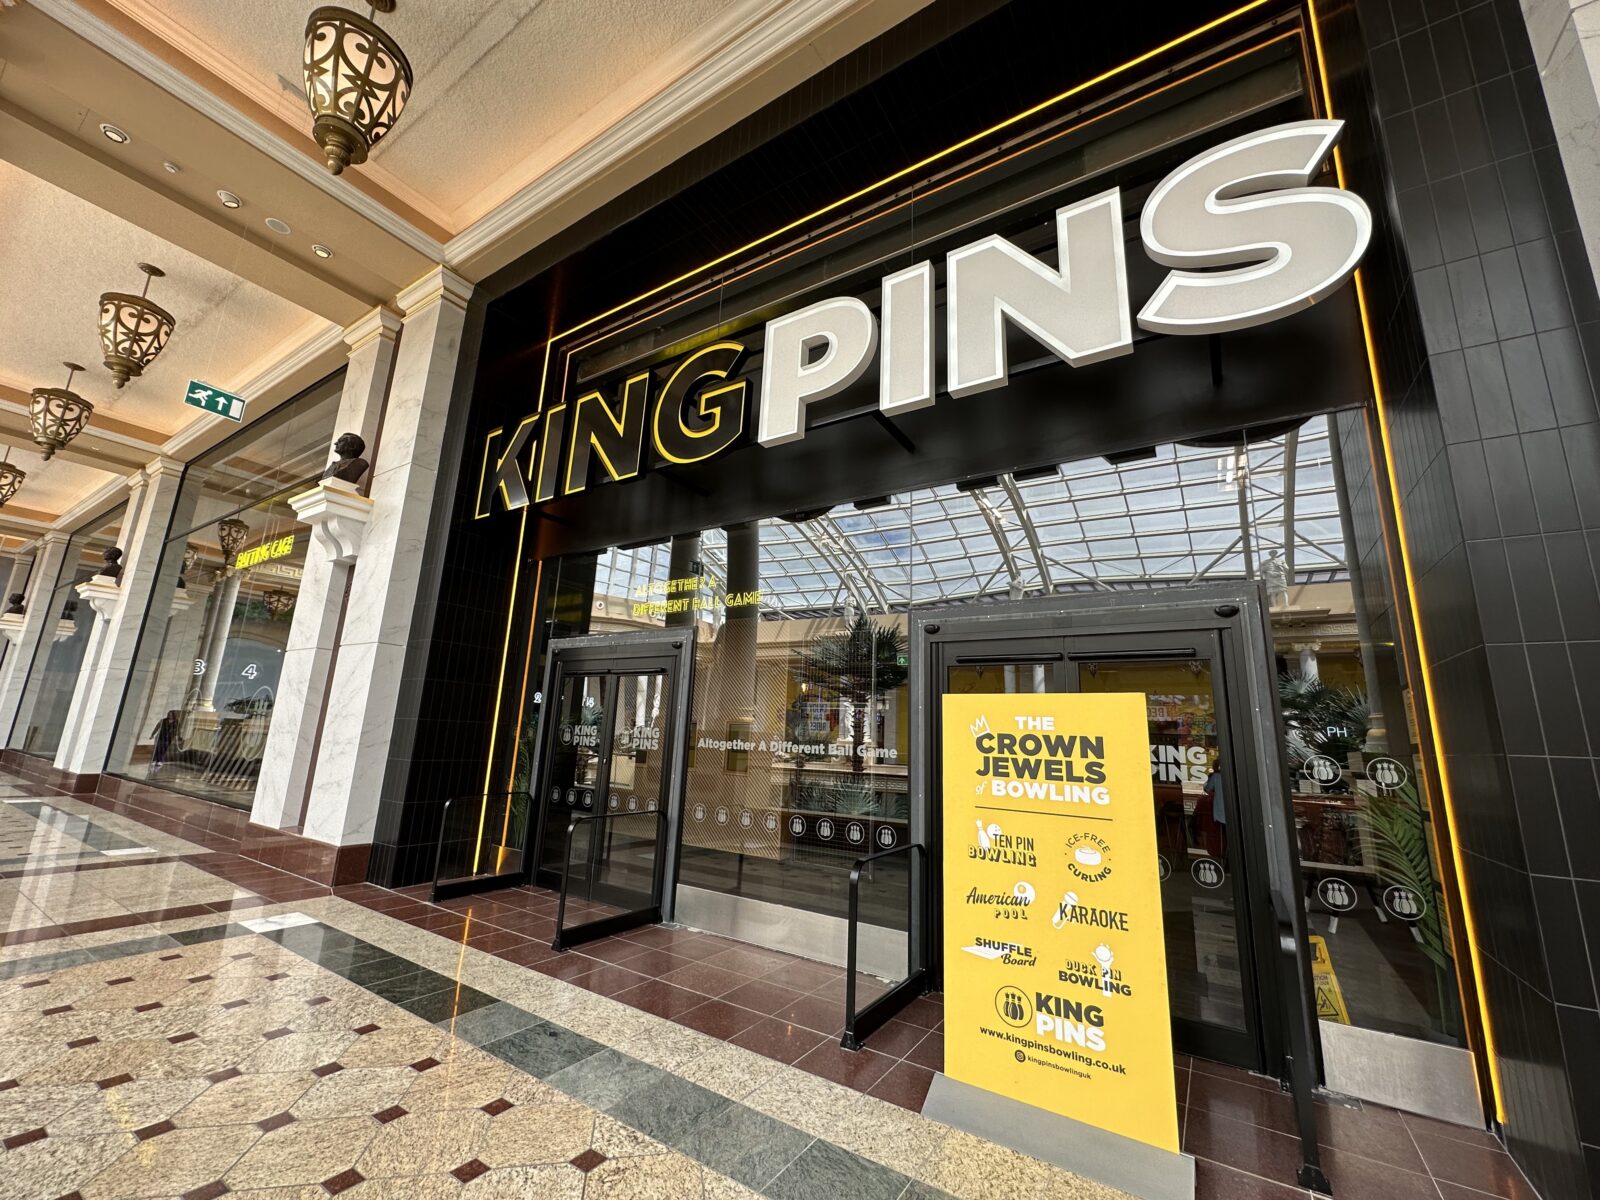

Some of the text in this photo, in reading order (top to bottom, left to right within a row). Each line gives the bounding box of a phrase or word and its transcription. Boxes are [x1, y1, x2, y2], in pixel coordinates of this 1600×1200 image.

[235, 534, 295, 569] BATTING CAGE
[634, 575, 718, 597] ALTOGETHER A
[633, 599, 690, 616] DIFFERENT
[724, 590, 763, 607] GAME
[193, 658, 206, 675] 3
[241, 664, 258, 680] 4
[574, 725, 598, 736] KING
[633, 727, 660, 739] KING
[1014, 716, 1055, 731] THE
[1326, 726, 1348, 738] PH
[572, 736, 596, 747] PINS
[632, 738, 659, 750] PINS
[698, 738, 898, 758] Altogether A Different Ball Game
[976, 732, 1104, 760] CROWN
[976, 756, 1106, 784] JEWELS
[976, 780, 1110, 806] of BOWLING
[993, 834, 1034, 851] TEN PIN
[1066, 832, 1111, 854] ICE-FREE
[968, 844, 1036, 868] BOWLING
[1068, 863, 1112, 882] CURLING
[966, 886, 1030, 907] American
[994, 909, 1028, 920] POOL
[1059, 902, 1128, 932] KARAOKE
[975, 937, 1032, 958] SHUFFLE
[1000, 953, 1037, 966] Board
[1066, 959, 1122, 981] DUCK PIN
[1058, 970, 1132, 996] BOWLING
[1036, 992, 1104, 1028] KING
[1036, 1012, 1106, 1052] PINS
[980, 1026, 1126, 1075] www.kingpinsbowling.co.uk
[1027, 1055, 1092, 1080] kingpinsbowlinguk
